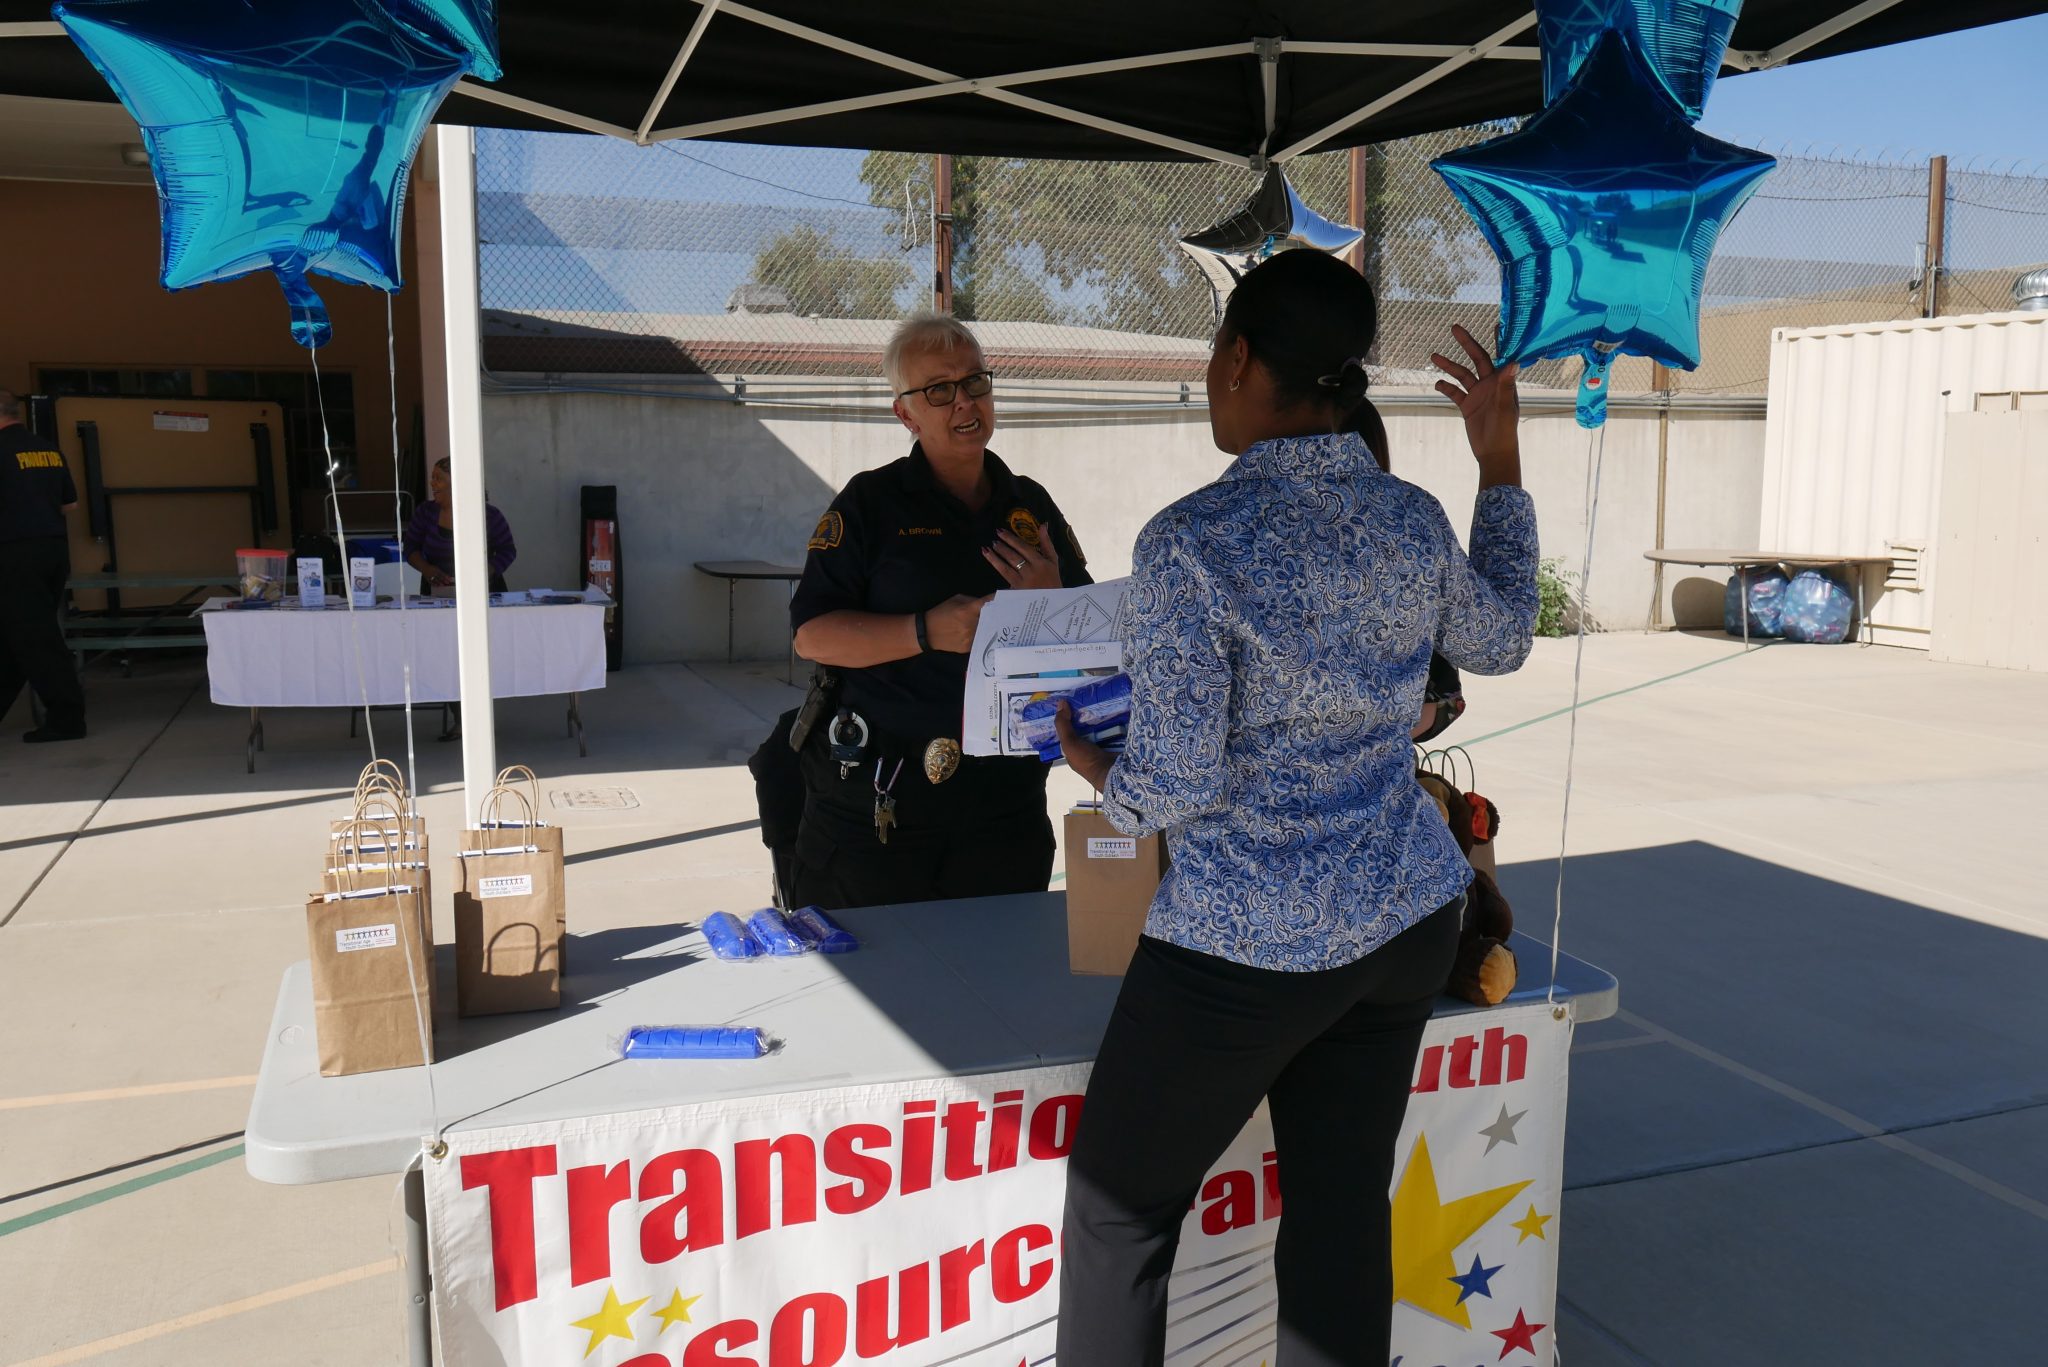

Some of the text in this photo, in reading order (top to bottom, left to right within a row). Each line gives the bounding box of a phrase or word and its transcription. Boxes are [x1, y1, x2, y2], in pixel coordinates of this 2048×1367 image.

[460, 1027, 1527, 1312] Transitio uth
[616, 1151, 1282, 1367] sourc ai
